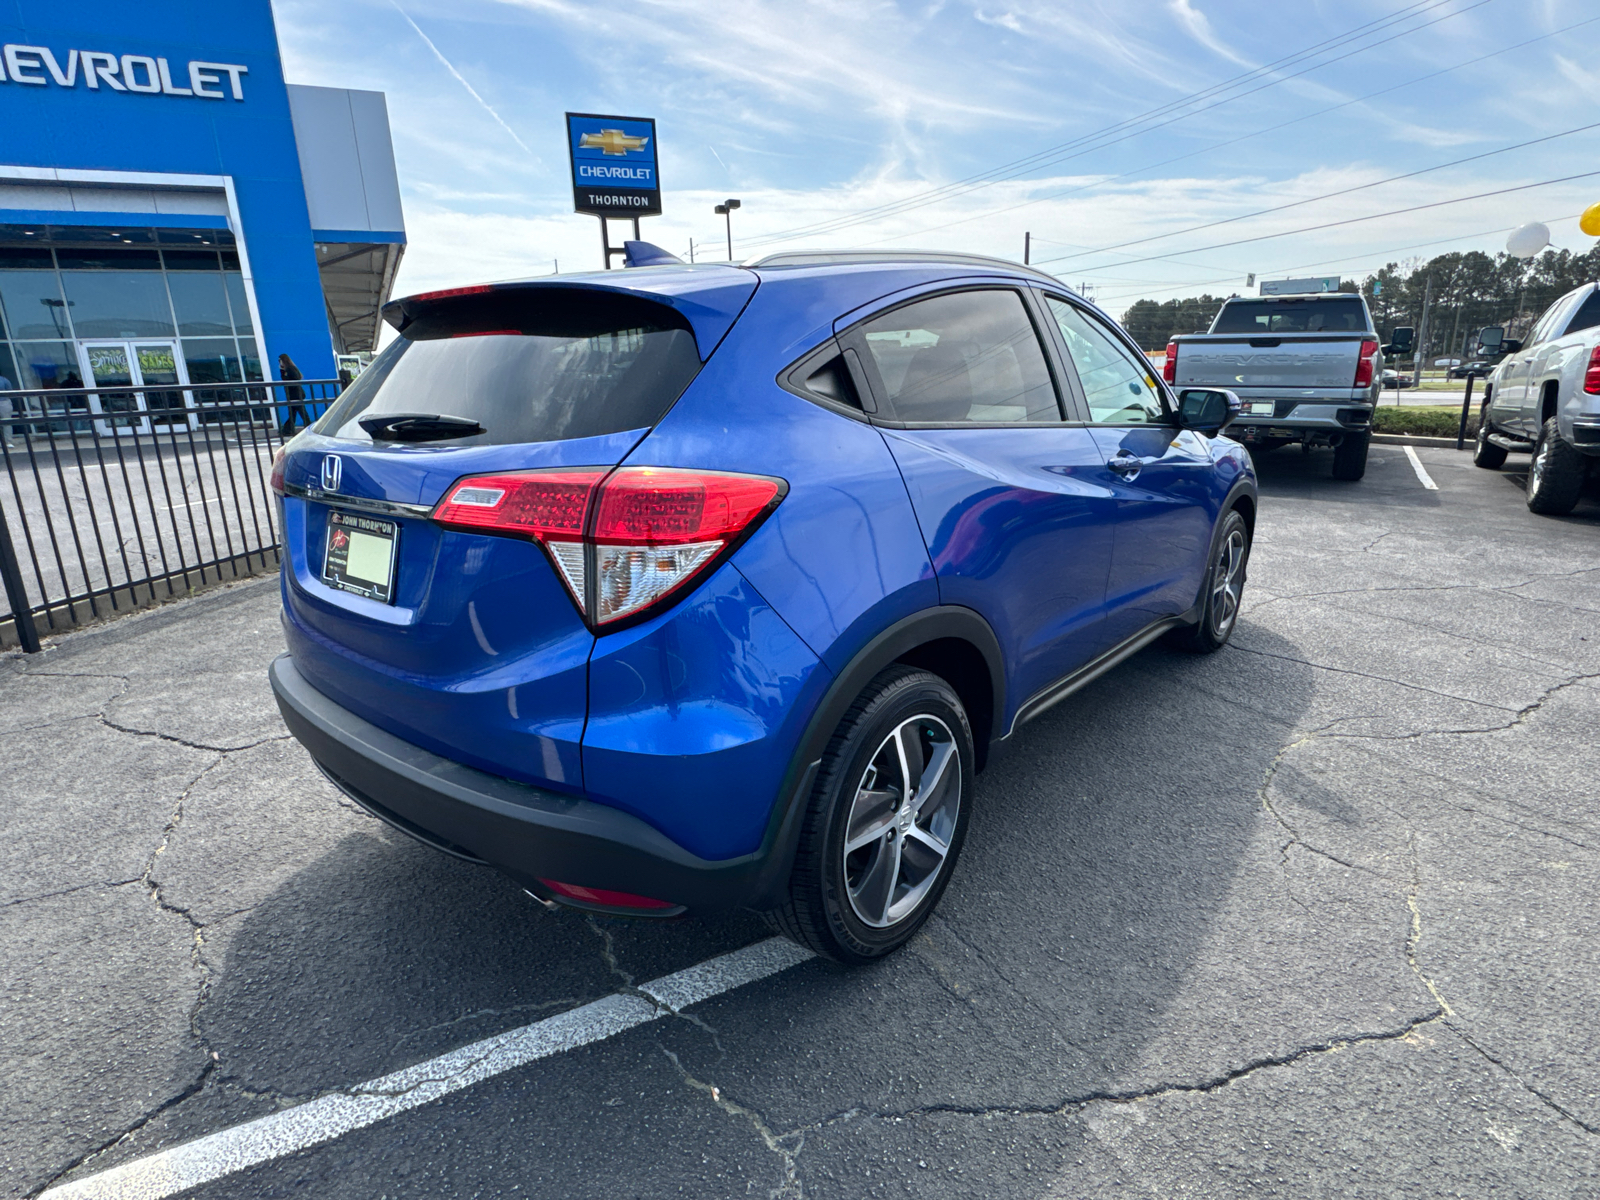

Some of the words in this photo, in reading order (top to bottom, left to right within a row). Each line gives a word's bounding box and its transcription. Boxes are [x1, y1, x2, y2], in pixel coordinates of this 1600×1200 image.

[0, 44, 248, 100] EVROLET
[580, 165, 651, 179] CHEVROLET
[589, 195, 649, 206] THORNTON
[342, 515, 358, 527] JOHN
[358, 518, 392, 534] THORNTON
